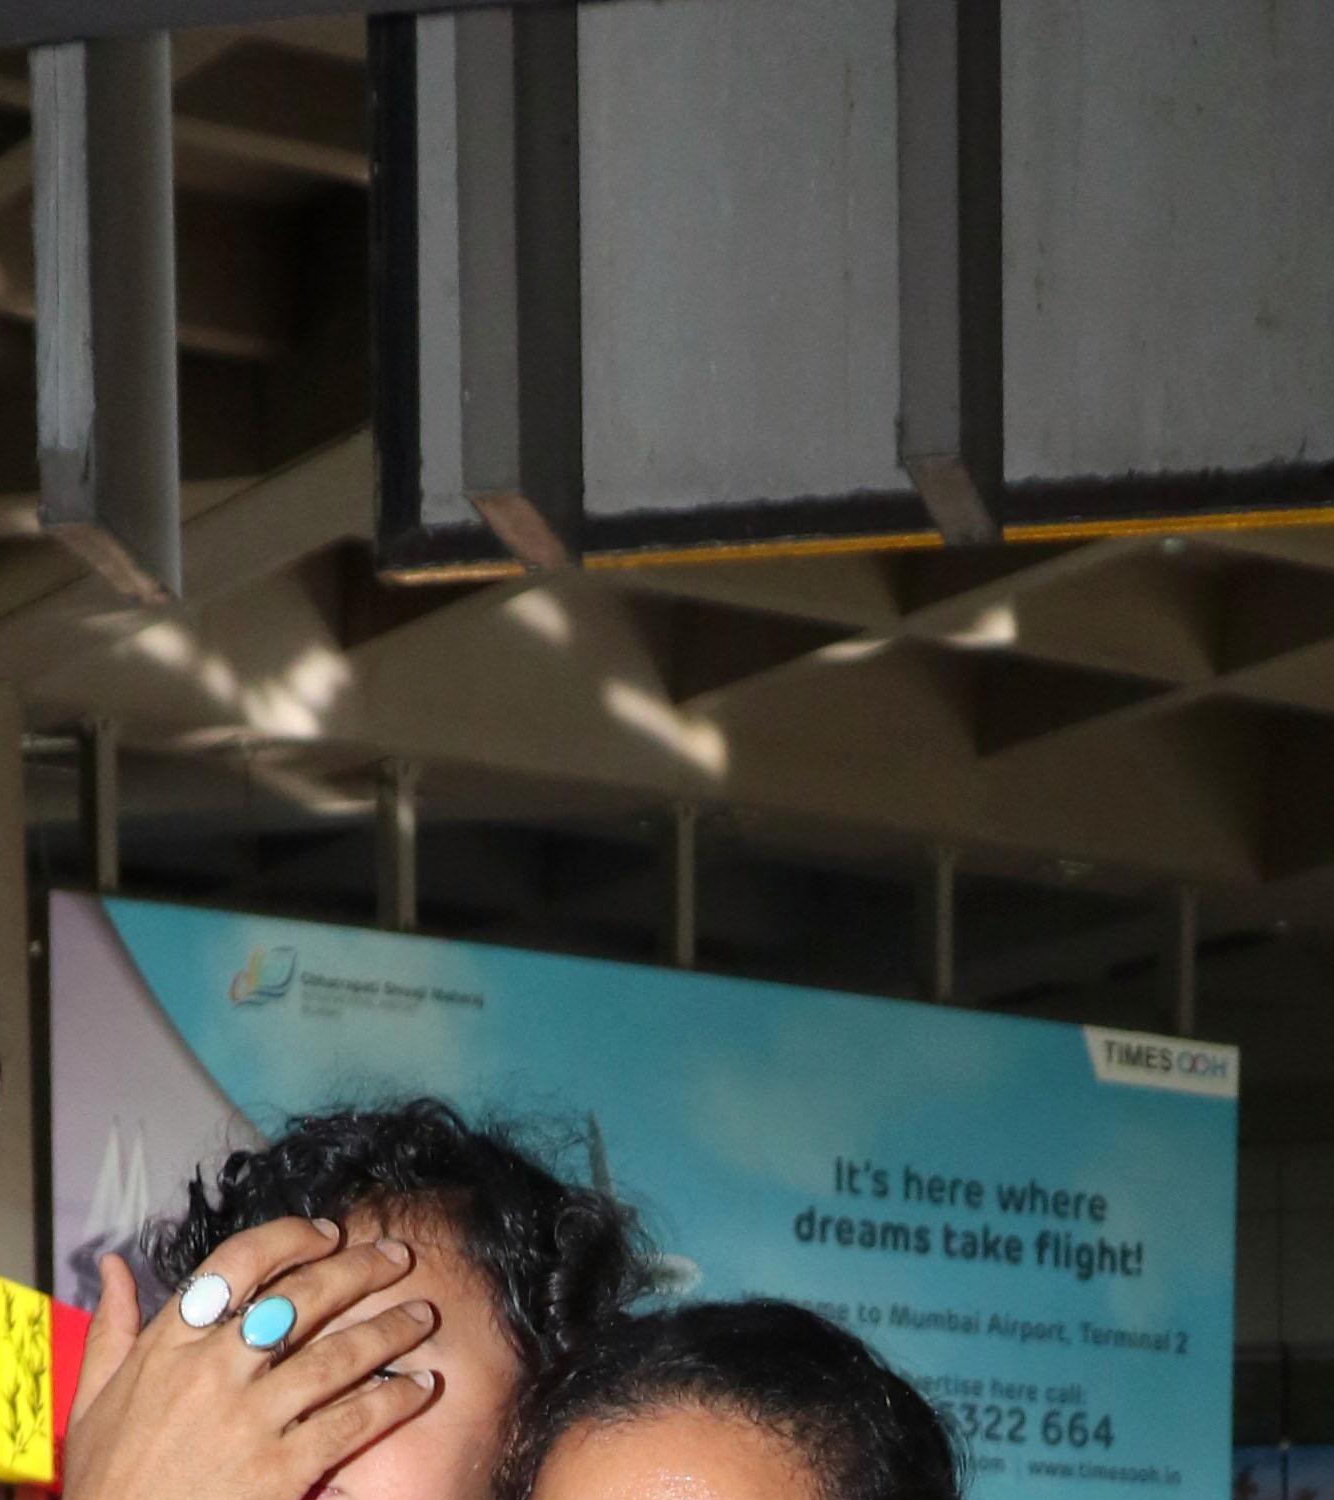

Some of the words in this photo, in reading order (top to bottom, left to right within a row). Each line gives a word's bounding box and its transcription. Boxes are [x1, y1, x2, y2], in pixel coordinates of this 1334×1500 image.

[1105, 1040, 1172, 1072] TIMES
[833, 1156, 889, 1198] It's
[903, 1164, 984, 1207] here
[997, 1179, 1108, 1222] where
[793, 1205, 931, 1255] dreams
[942, 1222, 1023, 1264] take
[1035, 1228, 1144, 1281] flight!
[858, 1301, 882, 1324] to
[890, 1302, 979, 1334] Mumbai
[986, 1311, 1072, 1343] Airport,
[1081, 1320, 1170, 1352] Terminal
[1175, 1331, 1190, 1354] 2
[990, 1376, 1038, 1402] here
[1042, 1408, 1116, 1449] 664
